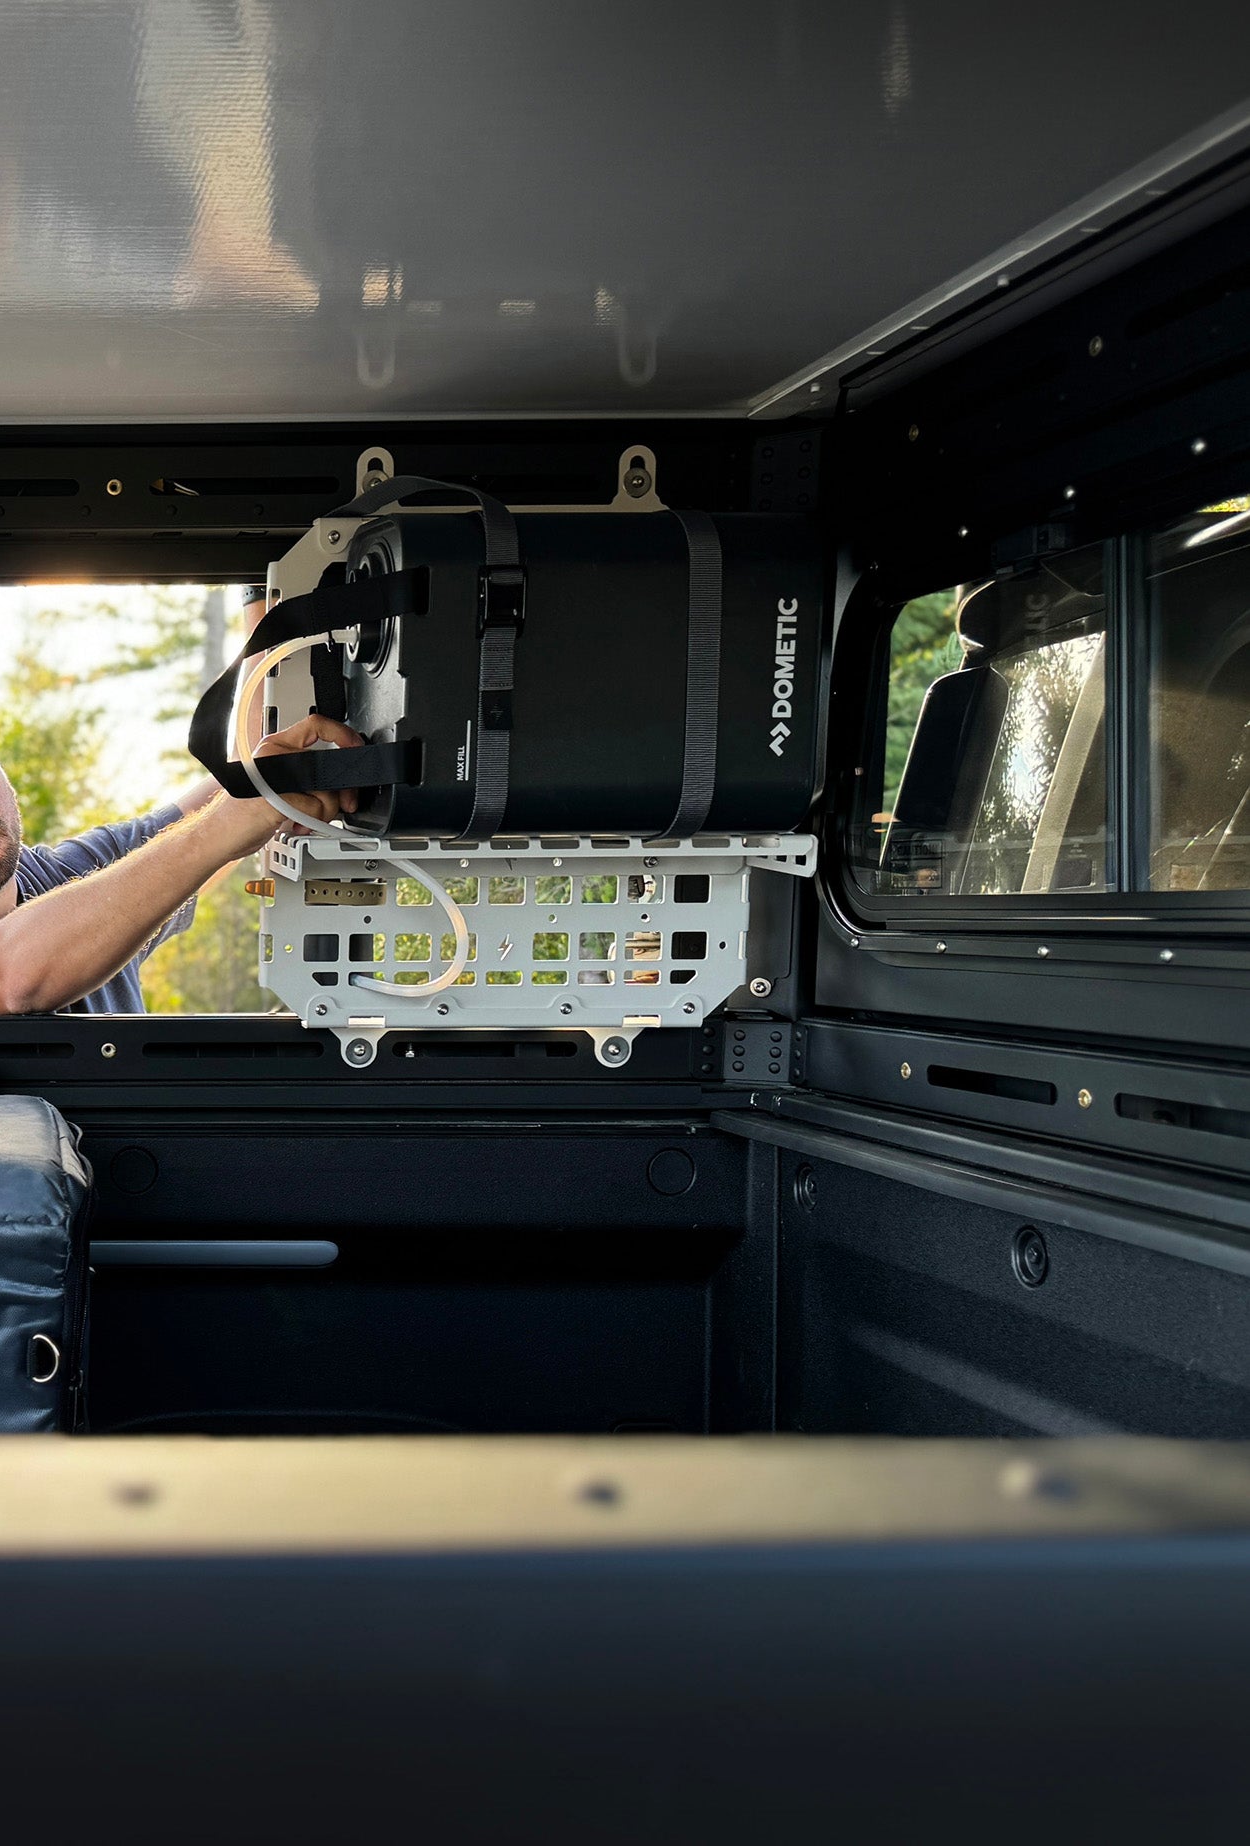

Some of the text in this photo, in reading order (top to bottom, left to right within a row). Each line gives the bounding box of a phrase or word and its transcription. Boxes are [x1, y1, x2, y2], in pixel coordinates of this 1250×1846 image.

[771, 598, 799, 718] DOMETIC
[456, 745, 465, 781] MAX FILL
